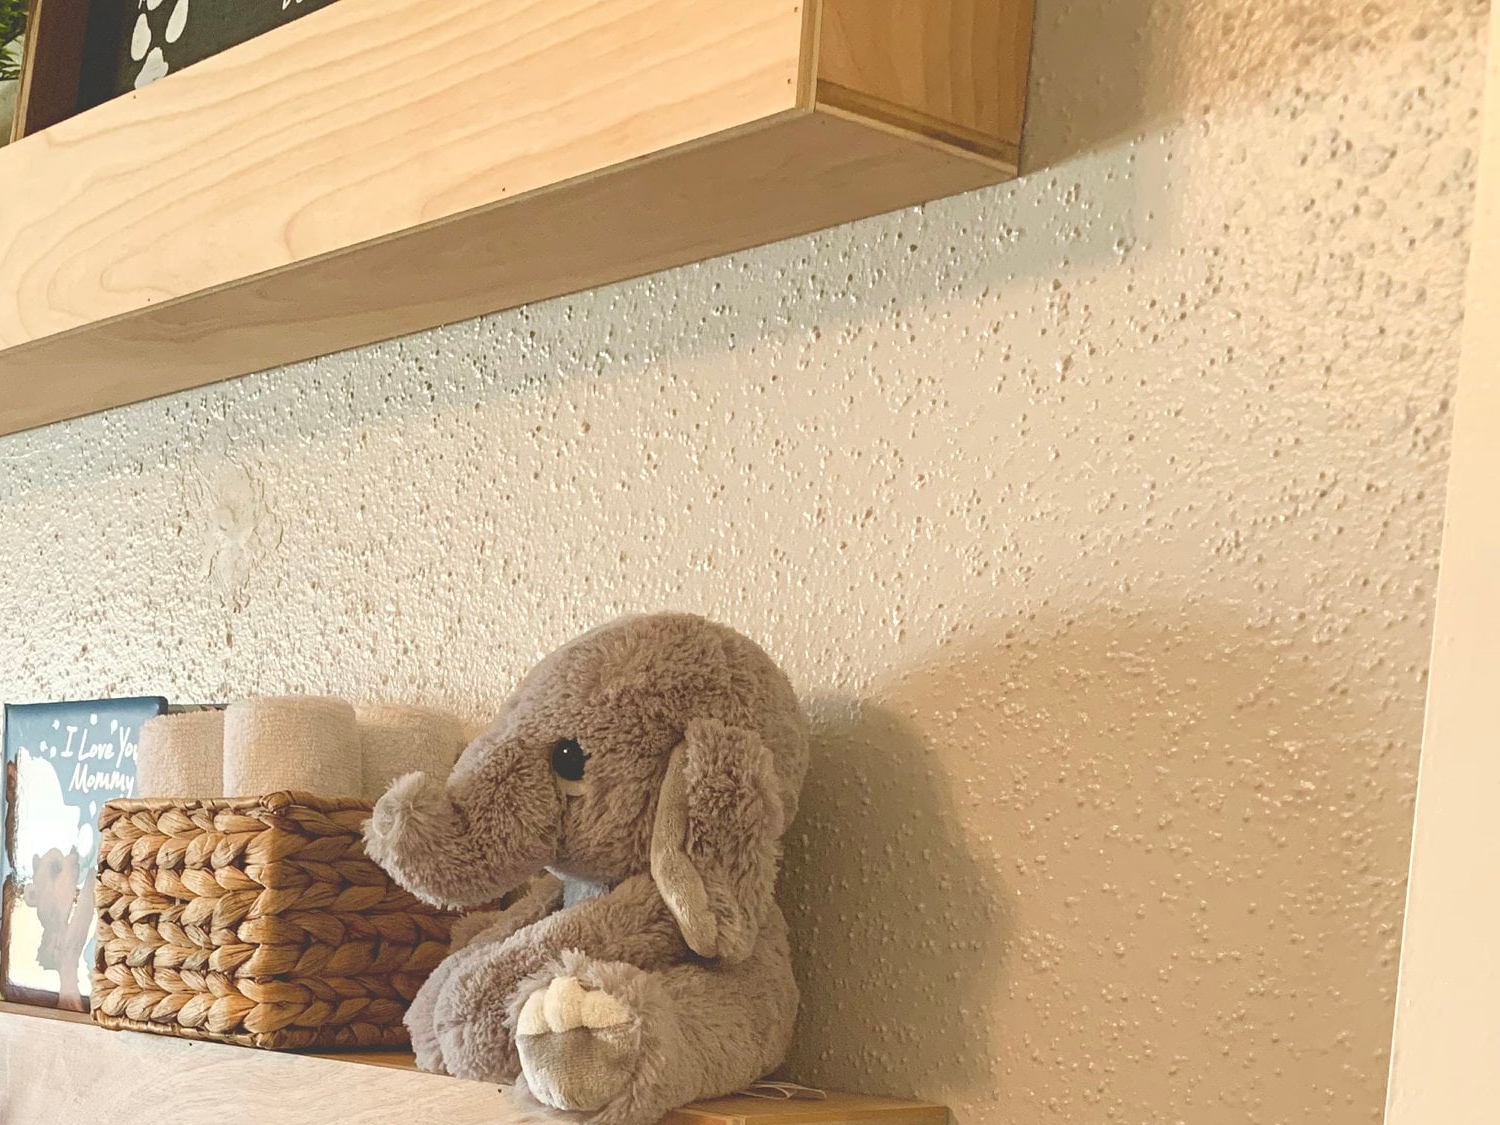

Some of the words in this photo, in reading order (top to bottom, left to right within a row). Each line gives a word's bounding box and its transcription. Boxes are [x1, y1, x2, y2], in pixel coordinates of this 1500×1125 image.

[60, 725, 78, 758] I
[78, 728, 115, 761] Love
[68, 762, 135, 799] Mommy
